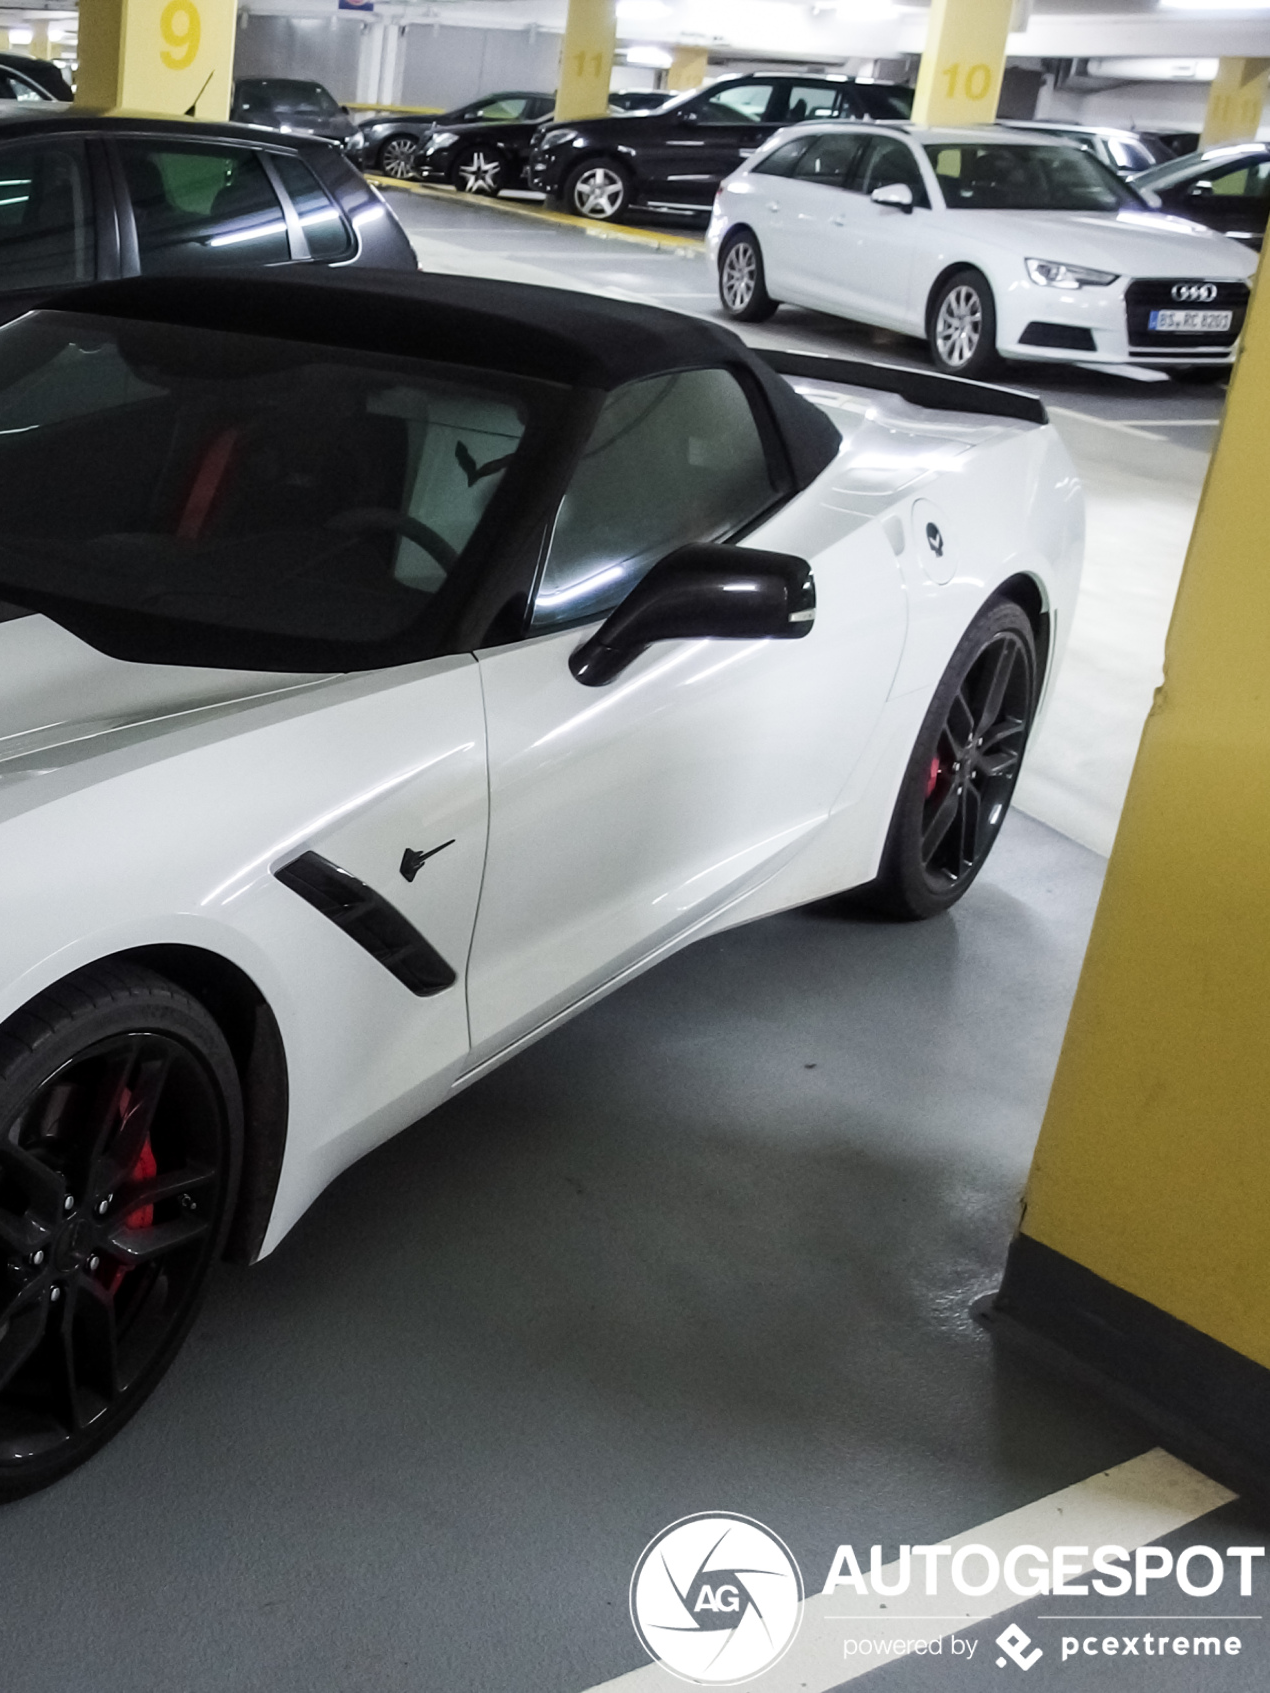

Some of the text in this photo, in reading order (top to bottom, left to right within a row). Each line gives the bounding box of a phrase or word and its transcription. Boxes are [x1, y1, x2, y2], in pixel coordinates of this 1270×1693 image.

[160, 0, 201, 70] 9
[572, 50, 604, 78] 11
[942, 62, 992, 101] 10
